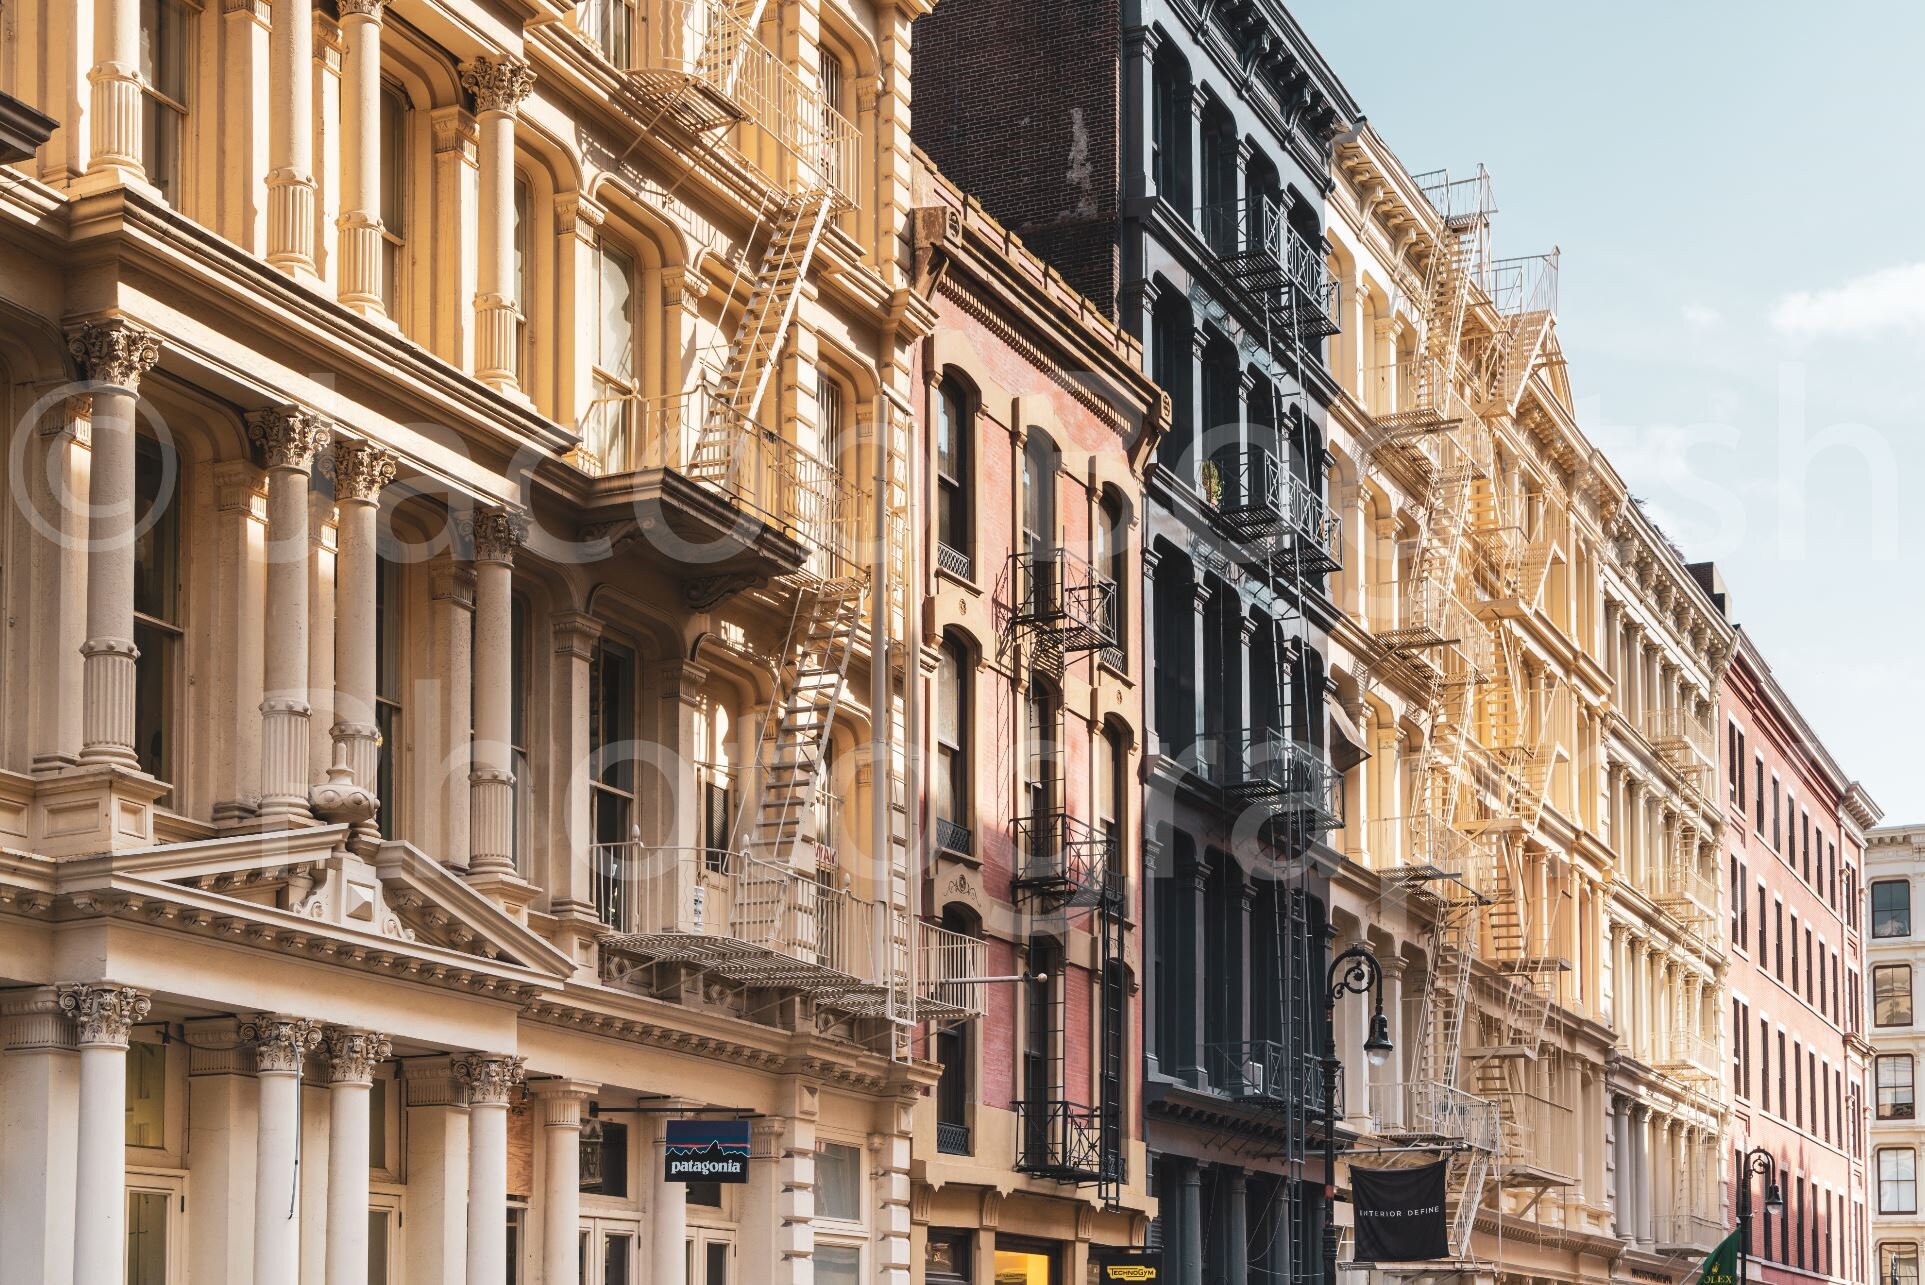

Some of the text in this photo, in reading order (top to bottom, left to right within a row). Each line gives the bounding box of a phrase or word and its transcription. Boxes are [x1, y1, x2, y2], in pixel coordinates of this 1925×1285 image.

[671, 1160, 740, 1175] patagonia
[1360, 1206, 1440, 1217] INTERIOR DEFINE
[1703, 1275, 1732, 1284] OLEX
